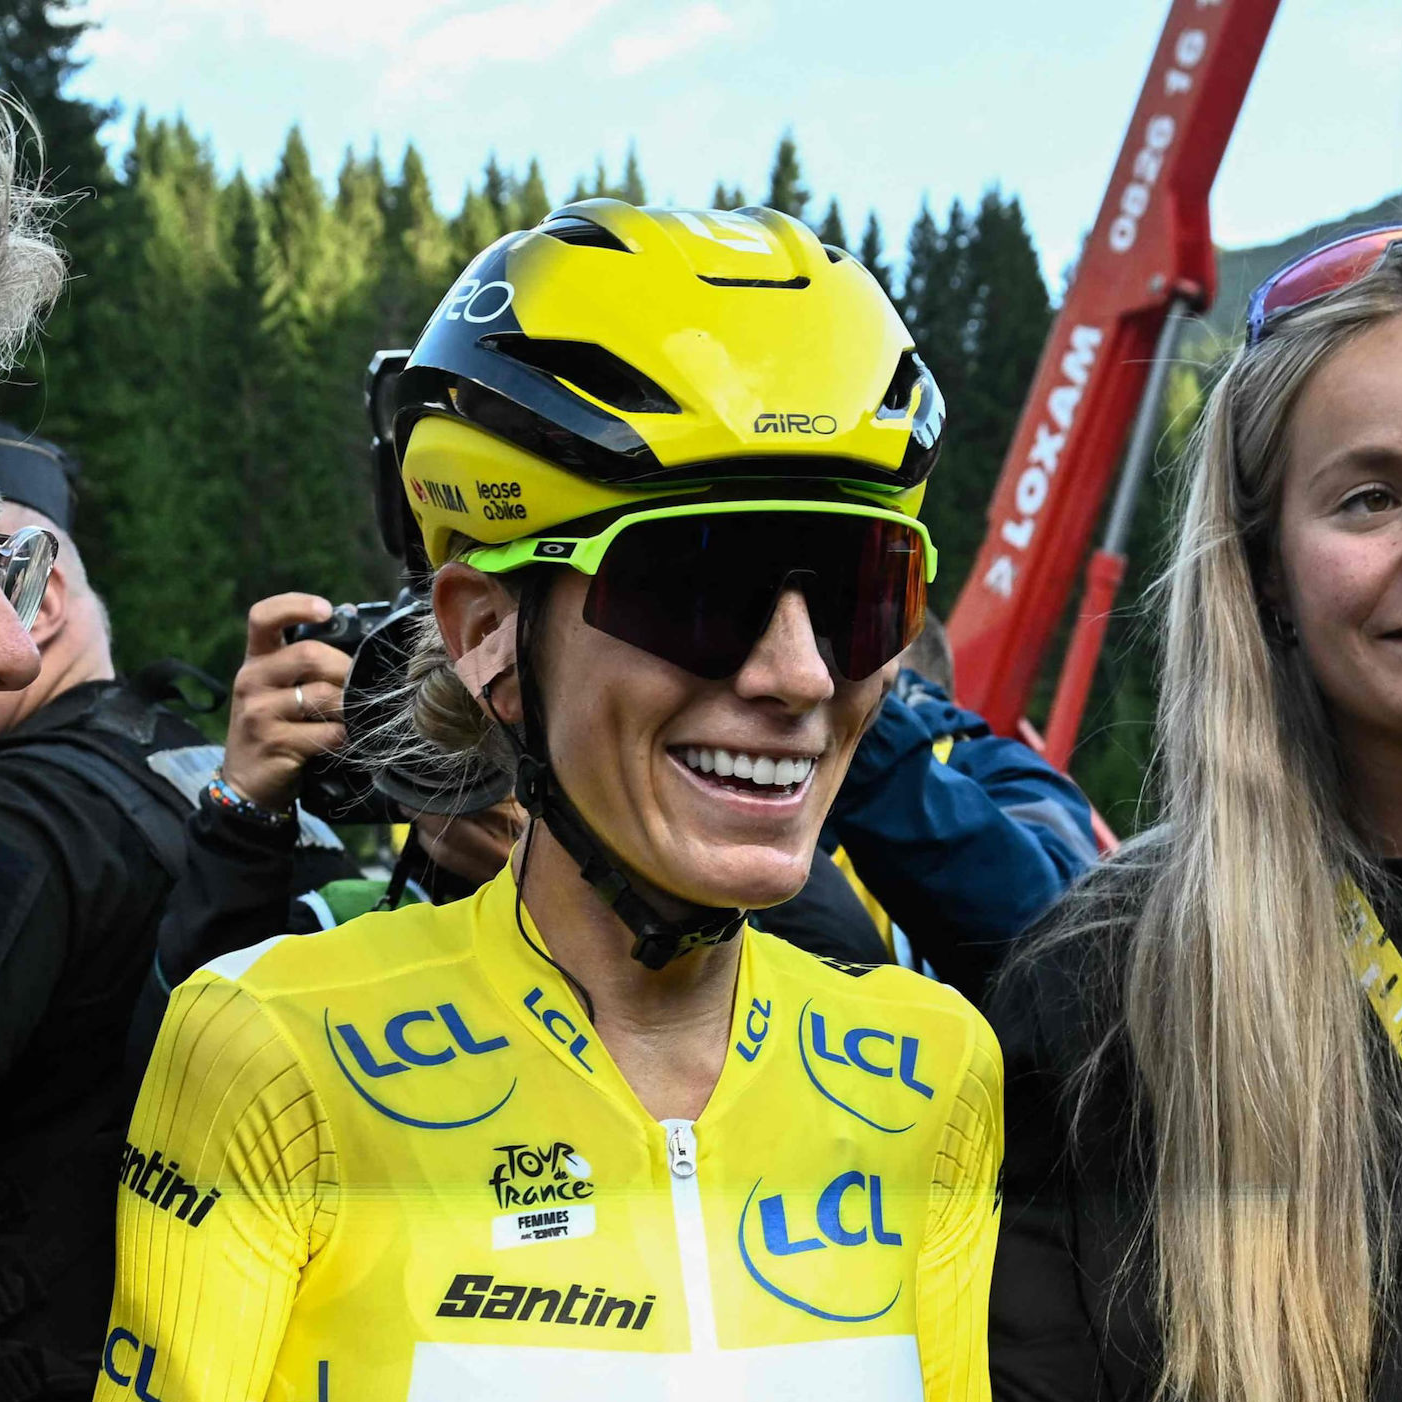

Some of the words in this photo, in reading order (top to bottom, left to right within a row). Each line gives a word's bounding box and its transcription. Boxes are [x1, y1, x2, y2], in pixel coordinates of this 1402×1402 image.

[754, 413, 837, 434] GIRO
[1001, 325, 1102, 550] LOXAM
[423, 479, 469, 514] VISMA
[475, 480, 521, 499] lease
[335, 1002, 509, 1080] LCL
[523, 987, 593, 1073] LCL
[736, 998, 771, 1062] LCL
[810, 1011, 934, 1100] LCL
[119, 1142, 222, 1228] antini
[492, 1141, 578, 1180] TOUR
[518, 1210, 569, 1229] FEMMES
[759, 1170, 902, 1257] LCL
[435, 1274, 656, 1330] Santini
